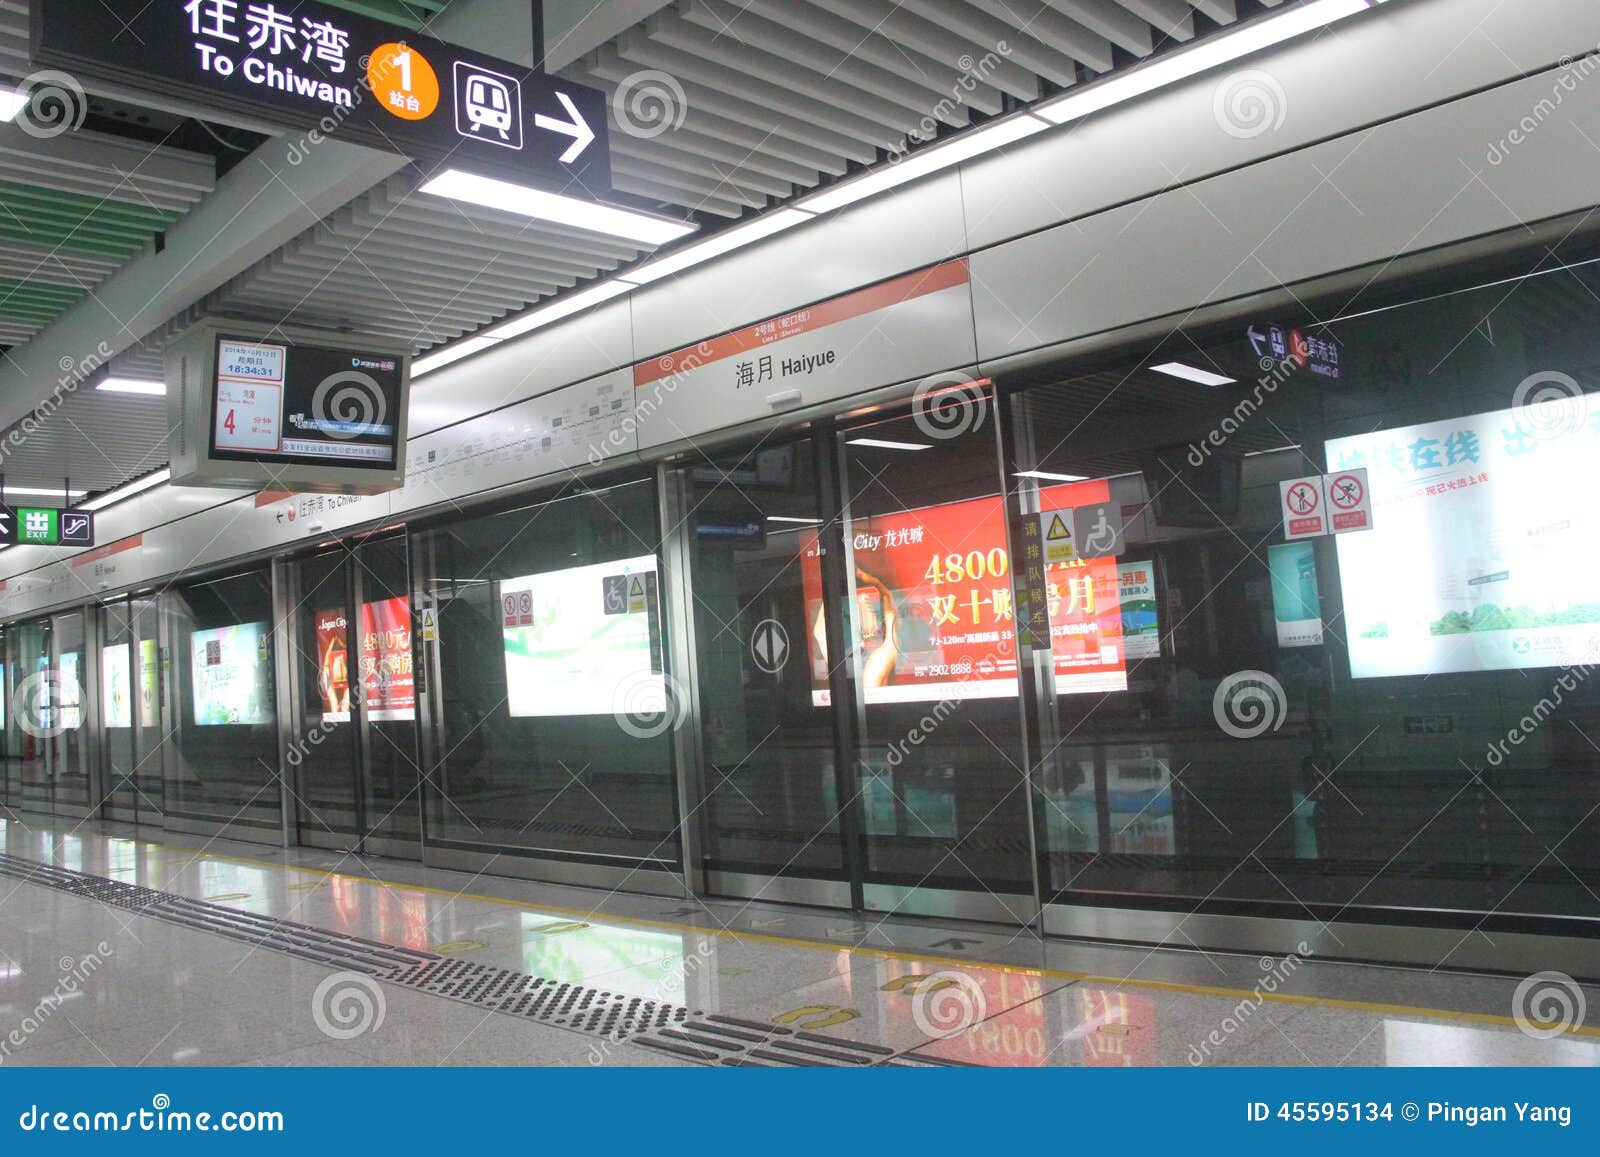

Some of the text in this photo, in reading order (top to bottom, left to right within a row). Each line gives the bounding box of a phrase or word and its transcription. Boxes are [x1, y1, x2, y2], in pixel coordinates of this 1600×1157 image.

[194, 42, 352, 107] To Chiwan
[393, 50, 411, 92] 1
[389, 90, 421, 112] 站台
[228, 364, 273, 376] 18:34:31
[735, 350, 835, 390] 海月 Haiyue
[224, 409, 235, 435] 4
[25, 511, 49, 531] 出
[854, 533, 881, 551] City
[924, 547, 1008, 585] 4800
[928, 664, 950, 677] 2902
